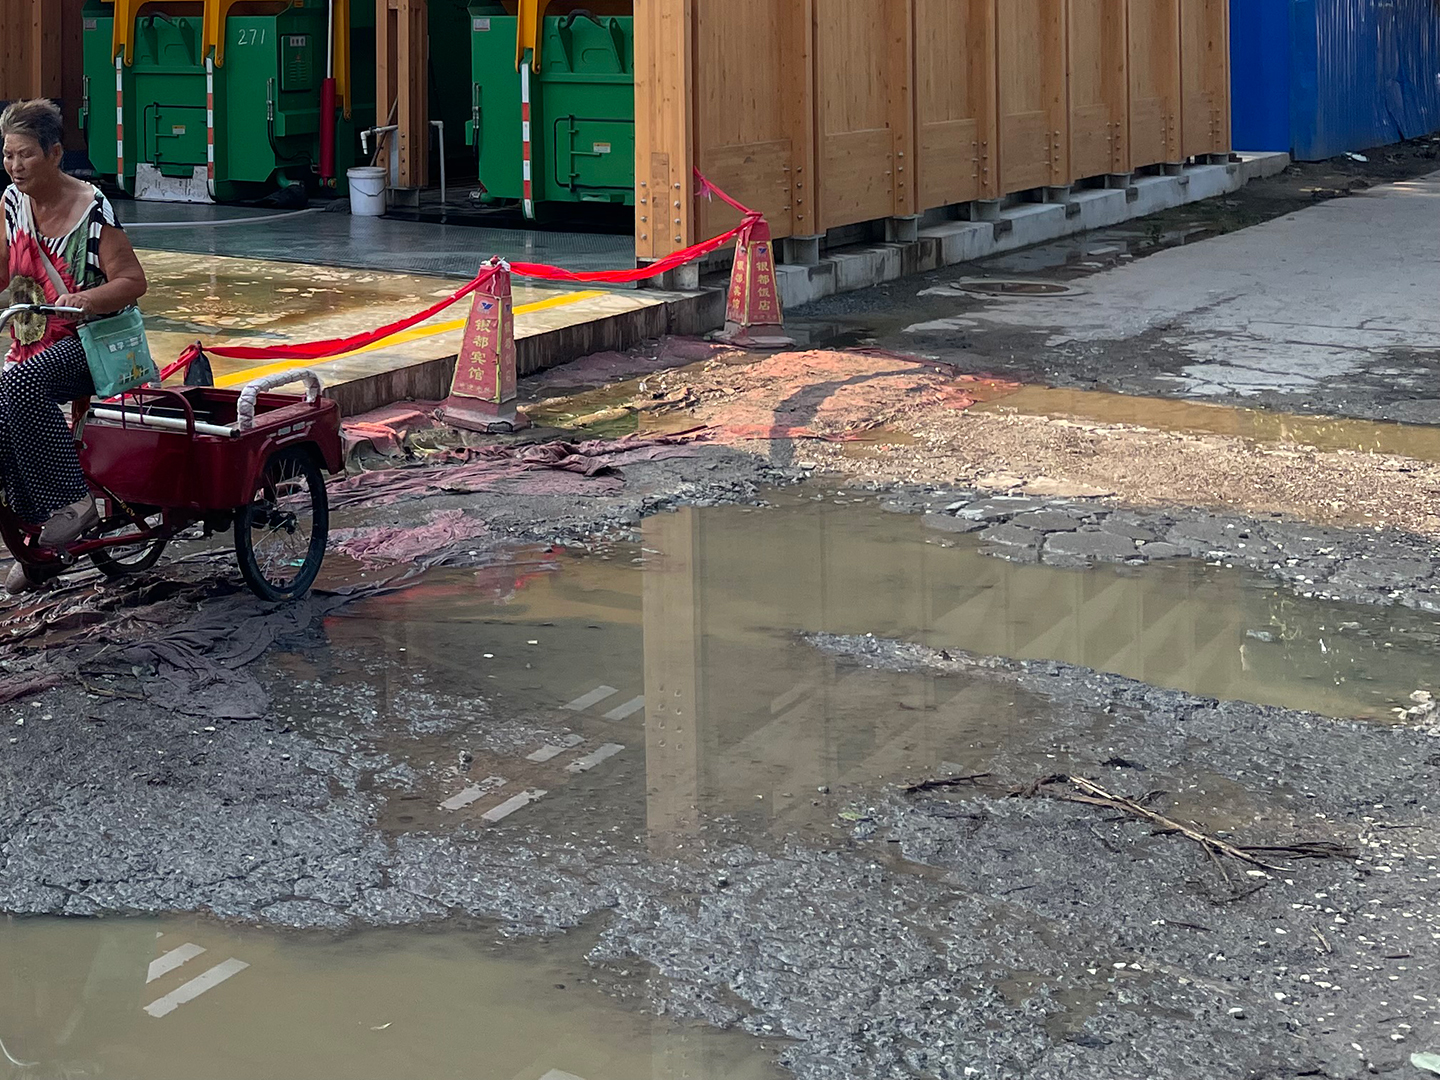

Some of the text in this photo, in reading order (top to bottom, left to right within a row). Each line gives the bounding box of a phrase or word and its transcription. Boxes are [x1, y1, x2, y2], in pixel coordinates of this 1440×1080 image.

[237, 28, 266, 46] 271
[467, 318, 492, 382] 银都宾馆
